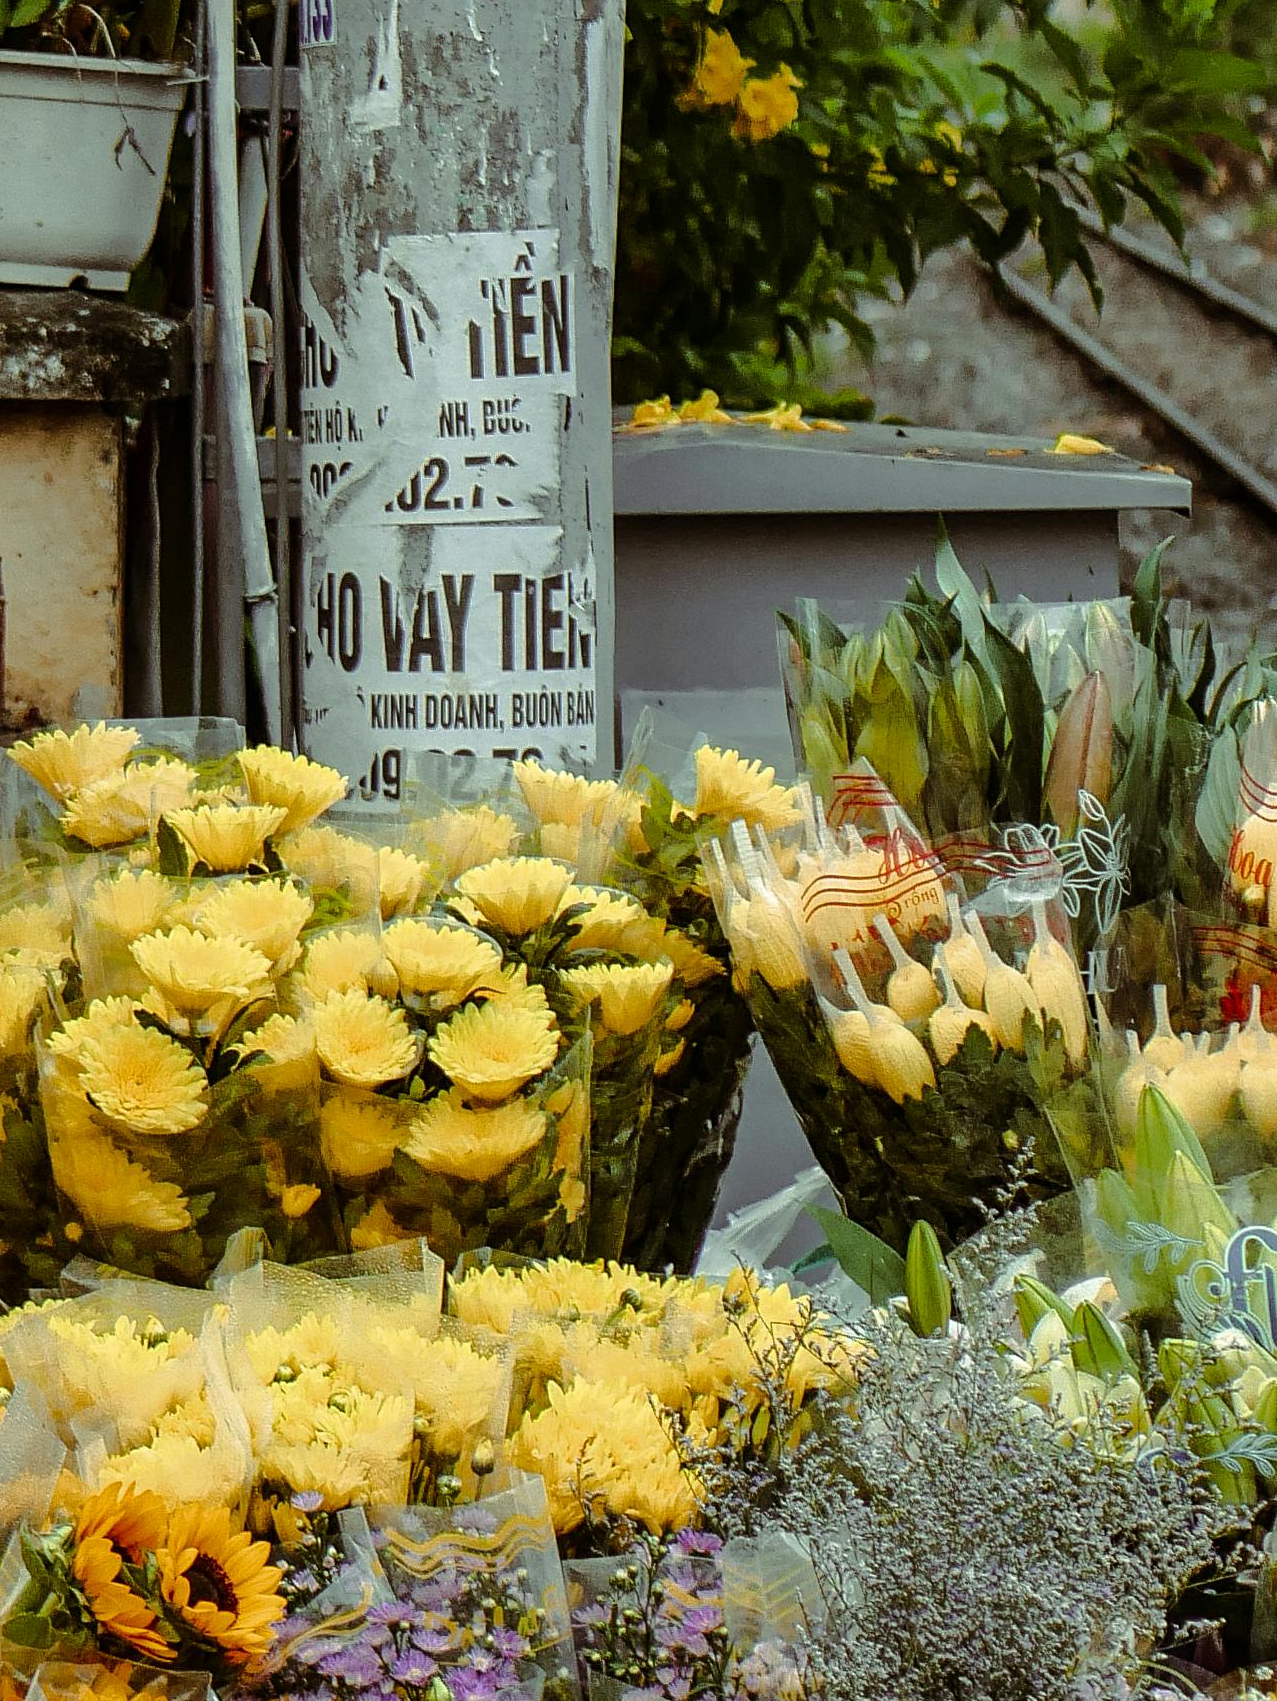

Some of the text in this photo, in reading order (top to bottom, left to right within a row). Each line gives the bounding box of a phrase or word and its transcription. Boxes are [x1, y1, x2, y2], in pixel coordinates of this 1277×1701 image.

[379, 572, 475, 673] VAY
[370, 693, 417, 731] KINH
[424, 694, 506, 734] DOANH,
[511, 684, 563, 729] BUÔN
[566, 682, 595, 726] BÁN
